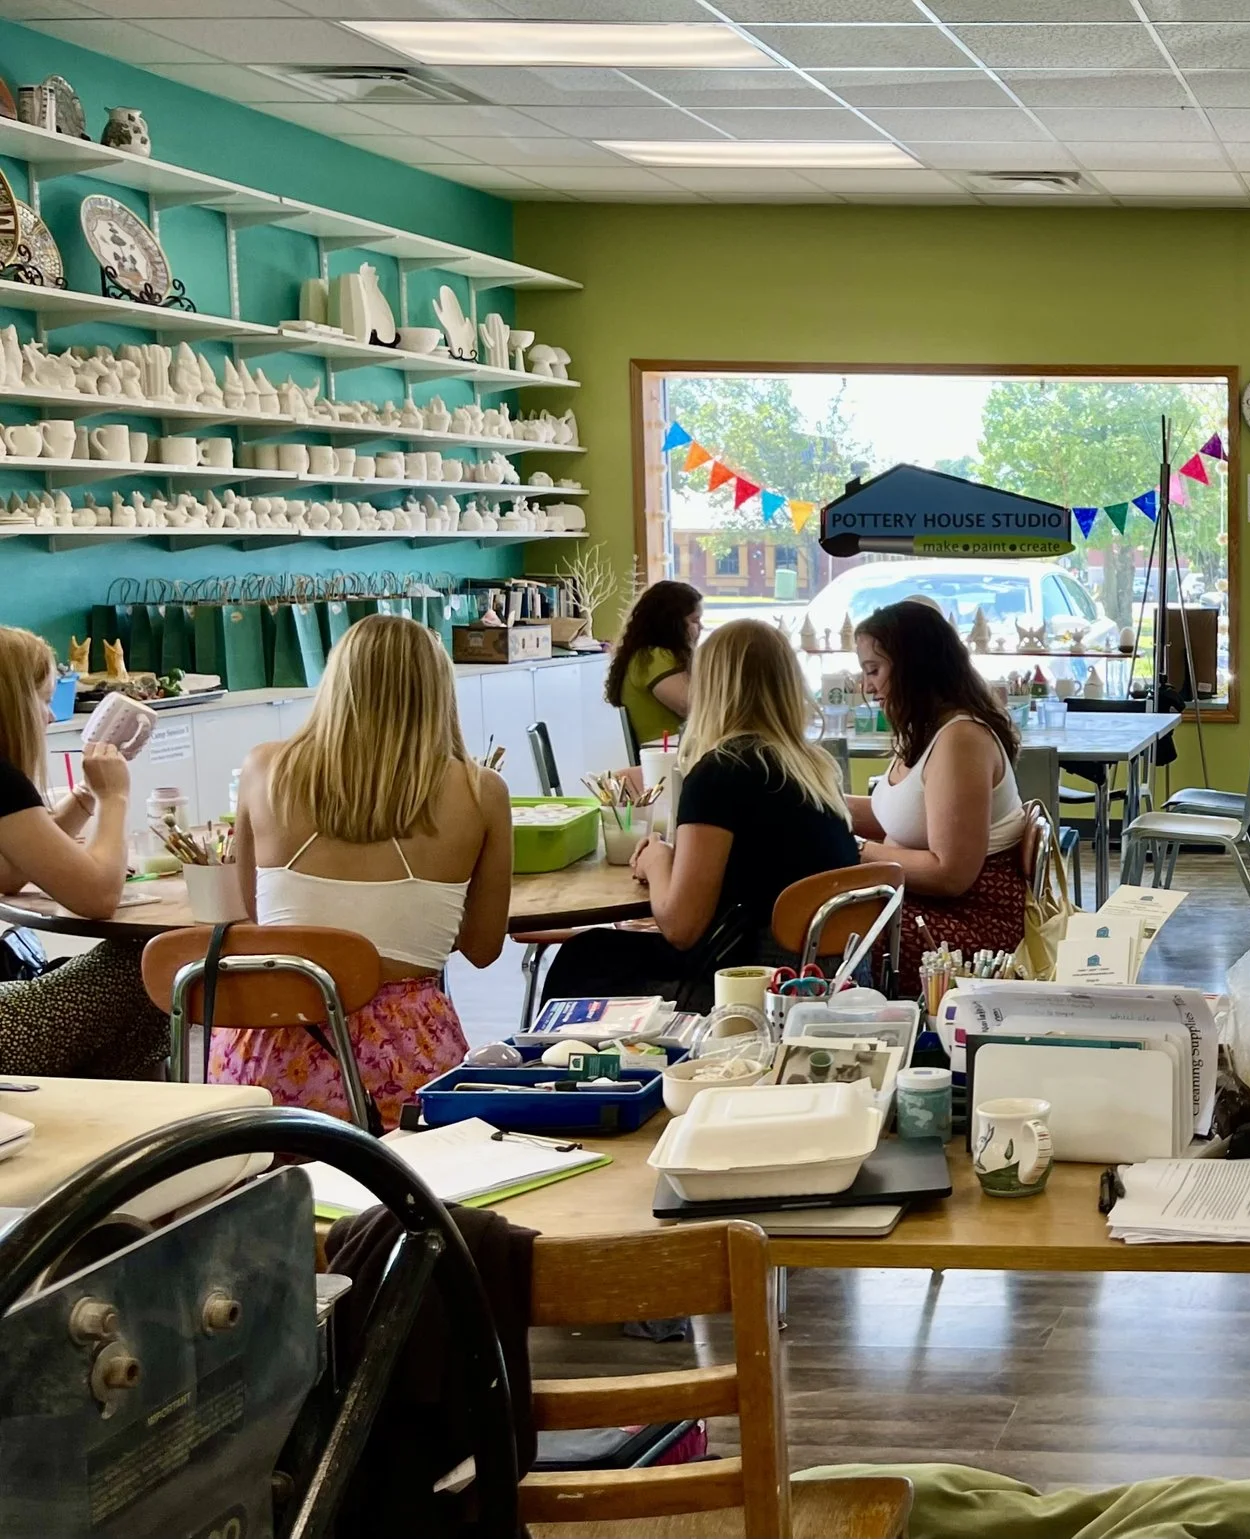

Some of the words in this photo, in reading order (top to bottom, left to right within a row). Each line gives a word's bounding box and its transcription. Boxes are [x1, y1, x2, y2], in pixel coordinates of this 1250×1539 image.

[832, 513, 917, 528] POTTERY
[923, 513, 986, 528] HOUSE
[992, 513, 1062, 528] STUDIO
[922, 540, 959, 552] make
[973, 540, 1006, 554] paint
[1020, 541, 1060, 553] create
[1185, 1012, 1201, 1055] Supplies
[1192, 1055, 1203, 1116] Cleaning
